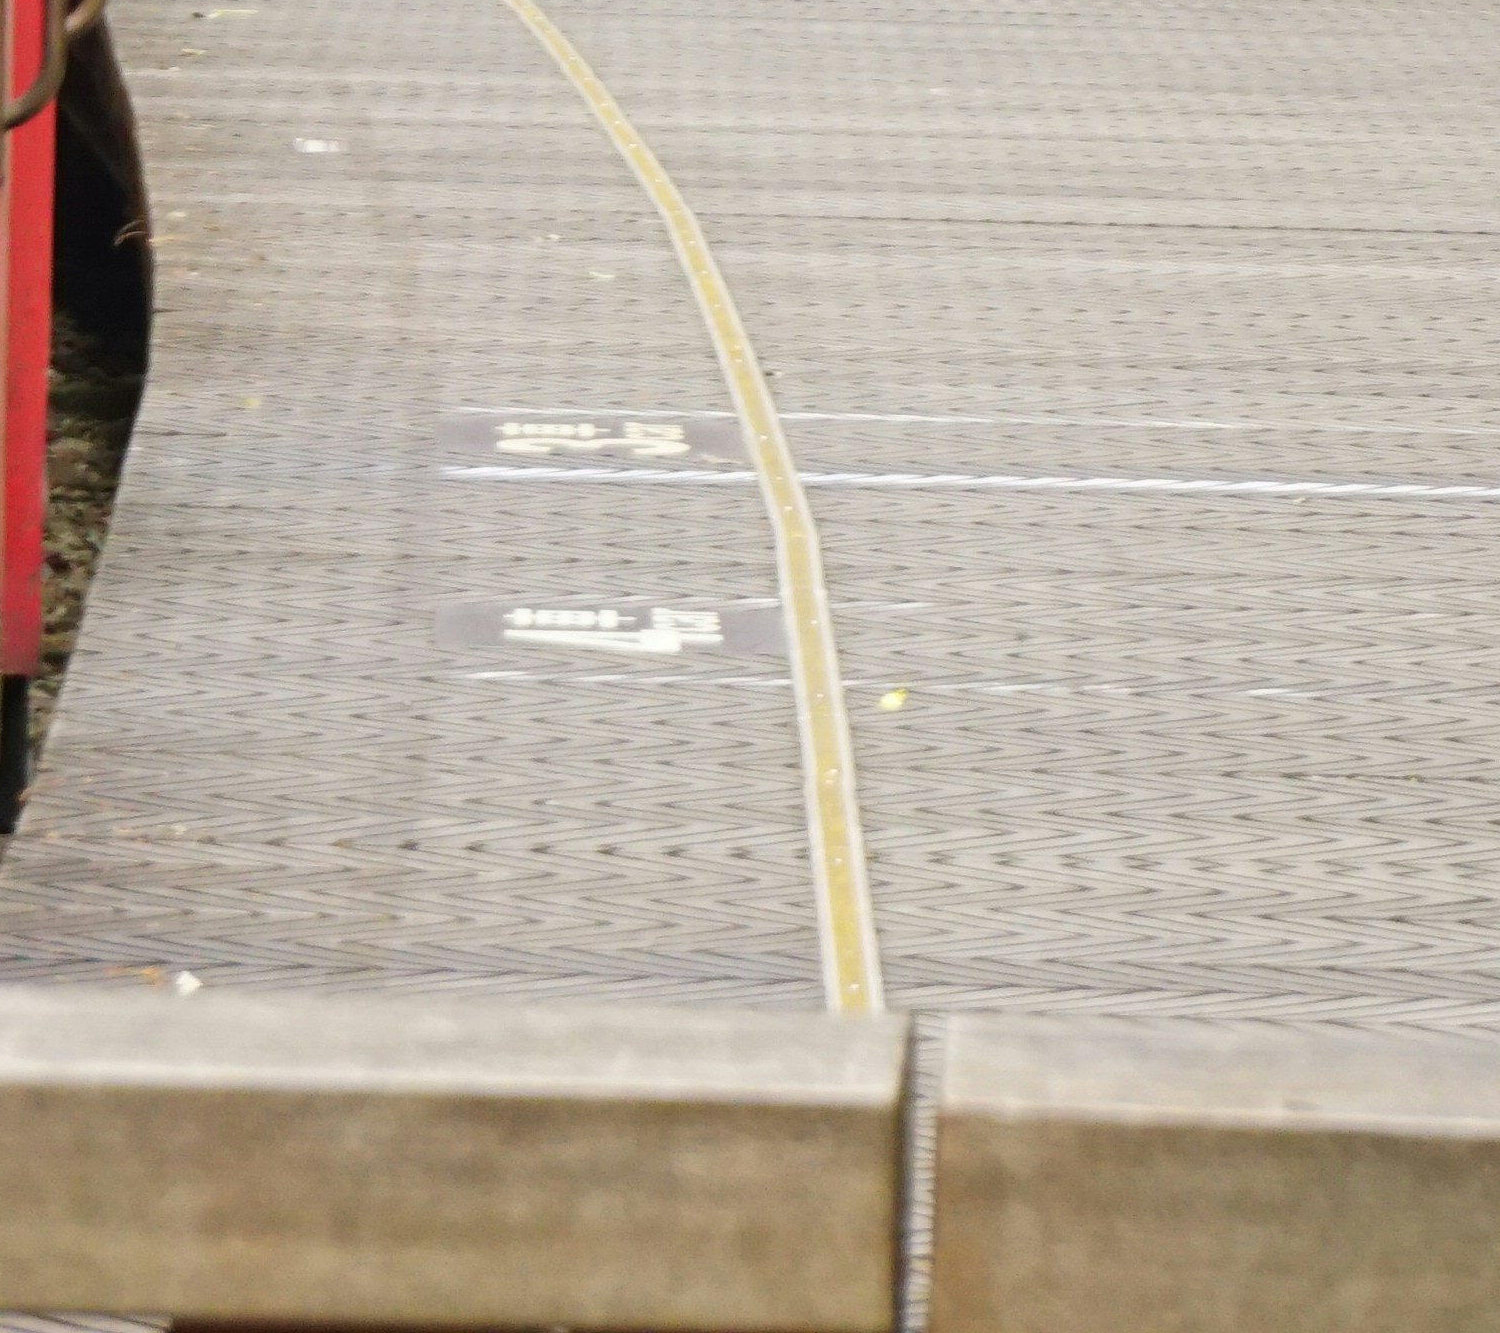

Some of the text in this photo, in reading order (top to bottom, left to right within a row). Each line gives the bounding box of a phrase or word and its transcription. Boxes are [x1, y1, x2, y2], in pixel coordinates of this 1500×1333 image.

[496, 437, 691, 455] 3
[502, 608, 638, 628] 車
[502, 628, 725, 654] 4
